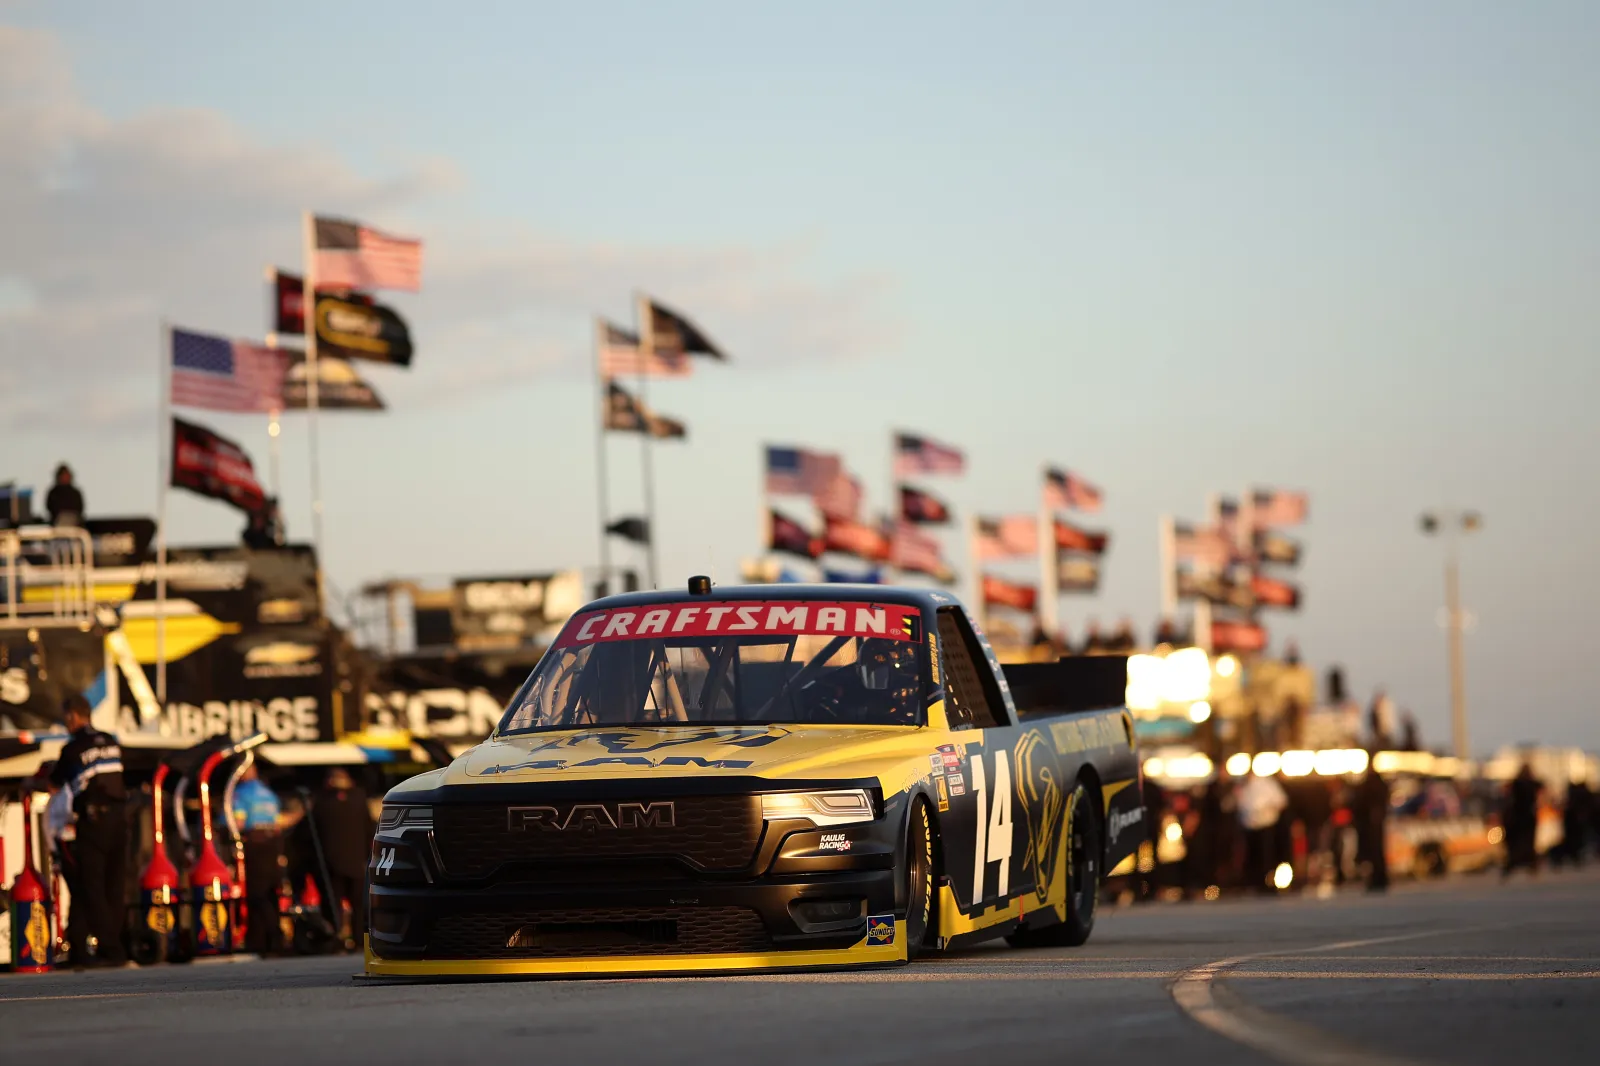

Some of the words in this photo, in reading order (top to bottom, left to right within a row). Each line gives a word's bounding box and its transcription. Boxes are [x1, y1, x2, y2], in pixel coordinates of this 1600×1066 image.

[575, 606, 887, 641] CRAFTSMAN
[507, 801, 676, 832] RAM
[970, 750, 1013, 905] 14
[818, 841, 845, 850] RACING
[820, 833, 846, 842] KAULIG
[375, 847, 396, 876] 14
[870, 927, 894, 938] SUNOCO
